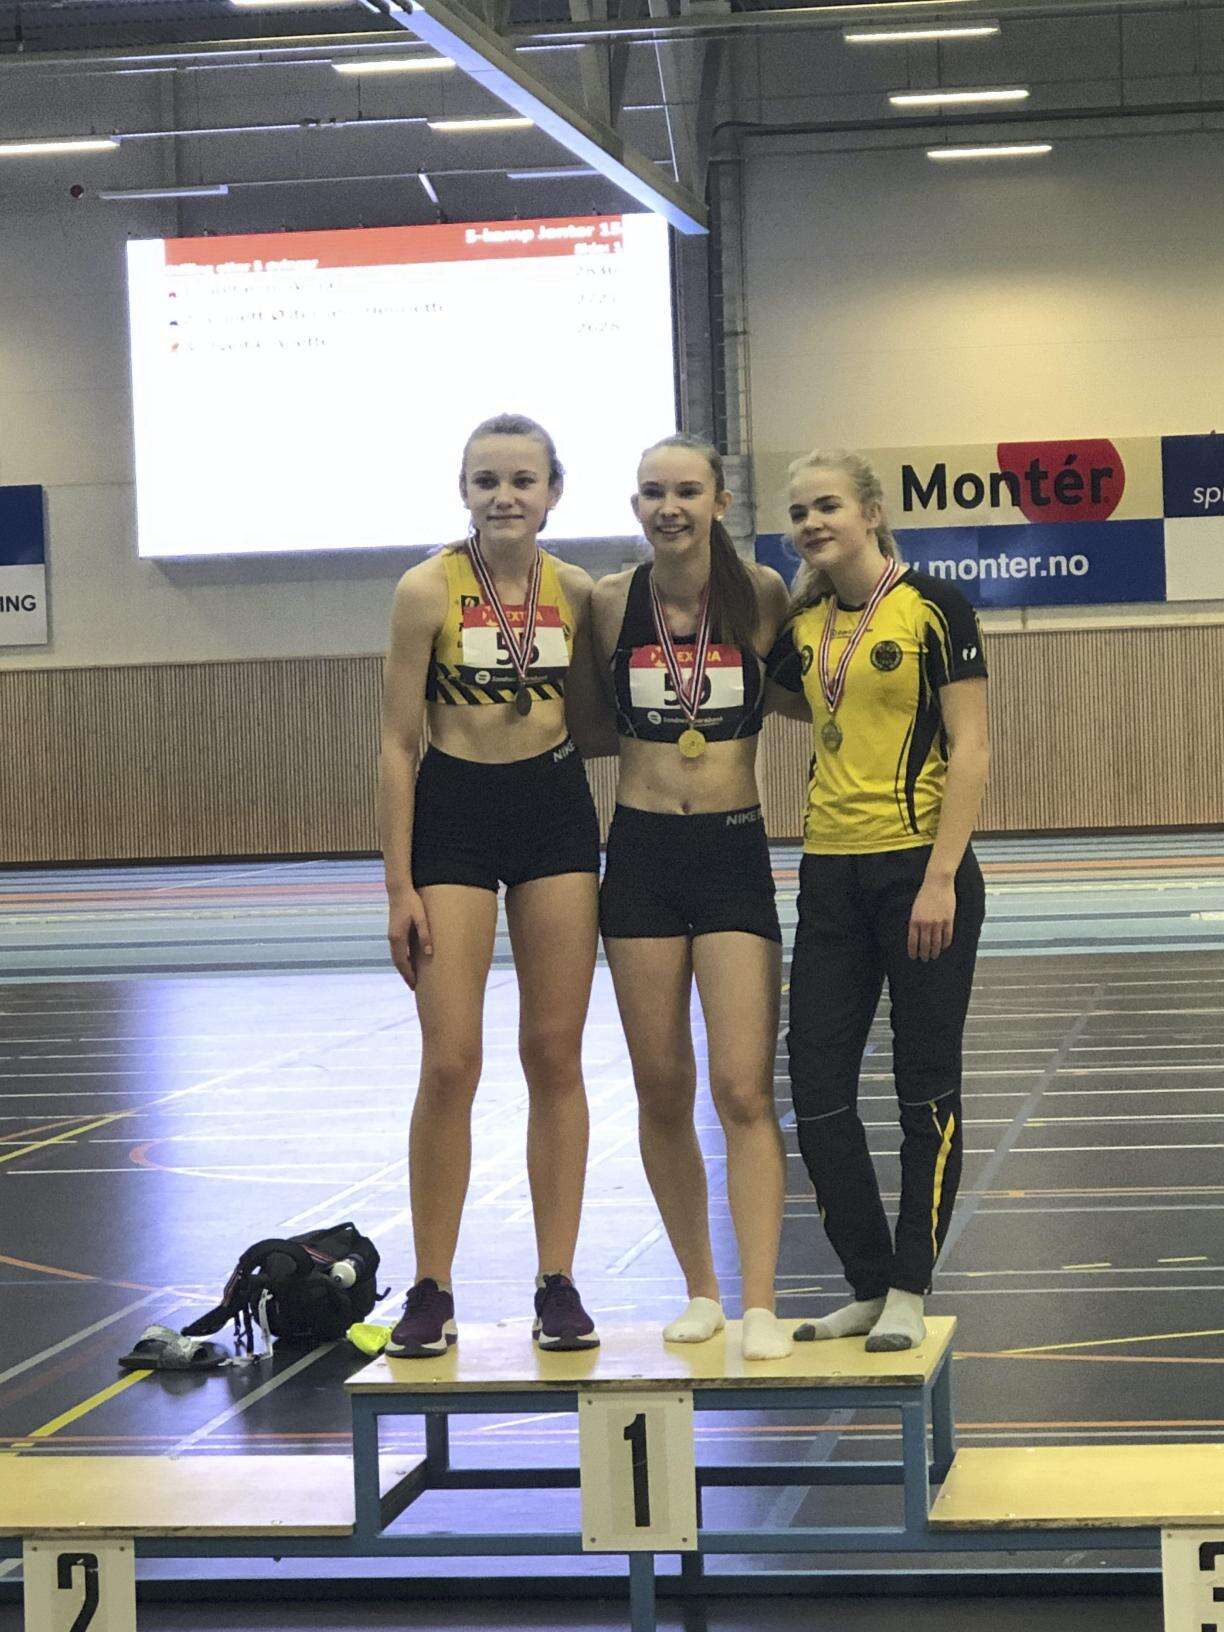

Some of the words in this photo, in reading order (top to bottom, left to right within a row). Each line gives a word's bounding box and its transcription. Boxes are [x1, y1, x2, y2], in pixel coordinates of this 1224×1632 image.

[901, 454, 1114, 511] Montér
[1193, 486, 1224, 509] sp
[623, 1413, 650, 1527] 1
[57, 1552, 99, 1632] 2
